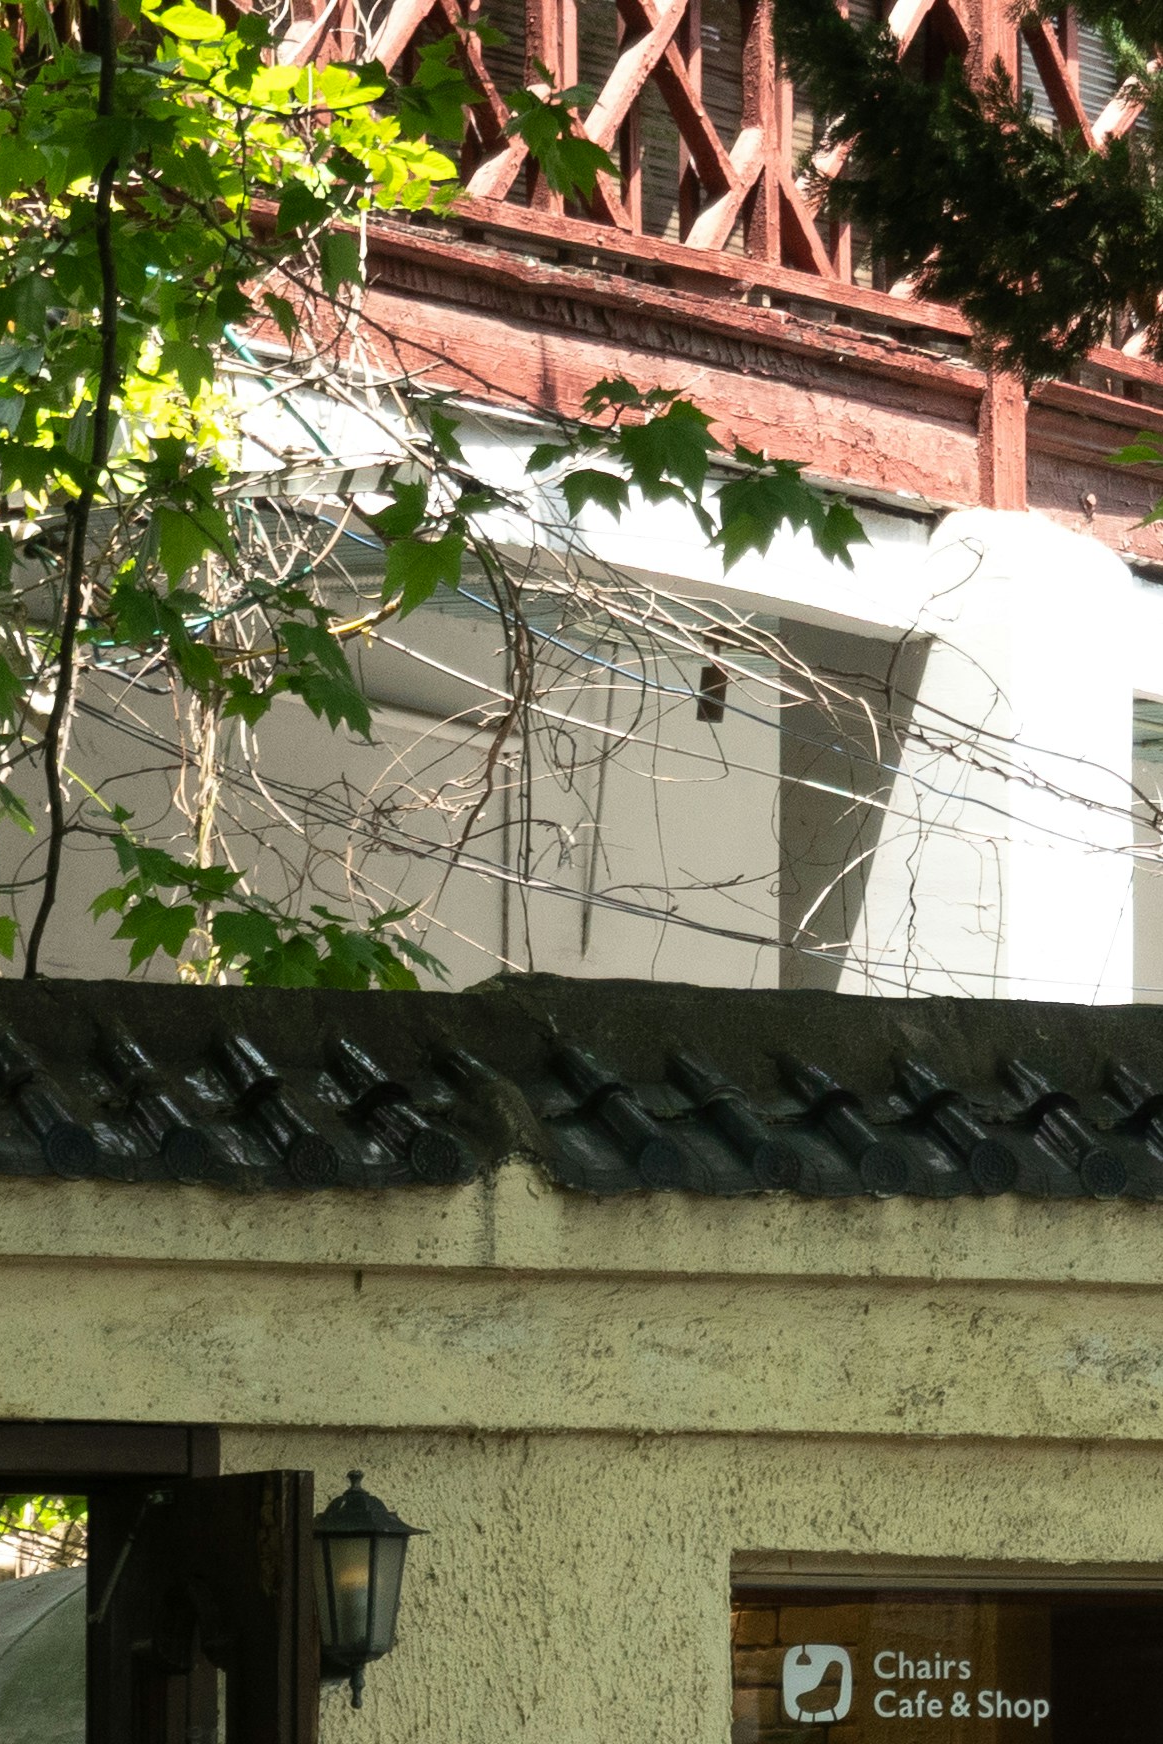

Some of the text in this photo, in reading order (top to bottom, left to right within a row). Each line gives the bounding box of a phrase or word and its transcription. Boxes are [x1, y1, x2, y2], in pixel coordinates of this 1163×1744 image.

[874, 1651, 971, 1679] Chairs
[874, 1690, 1049, 1727] Cafe & Shop
